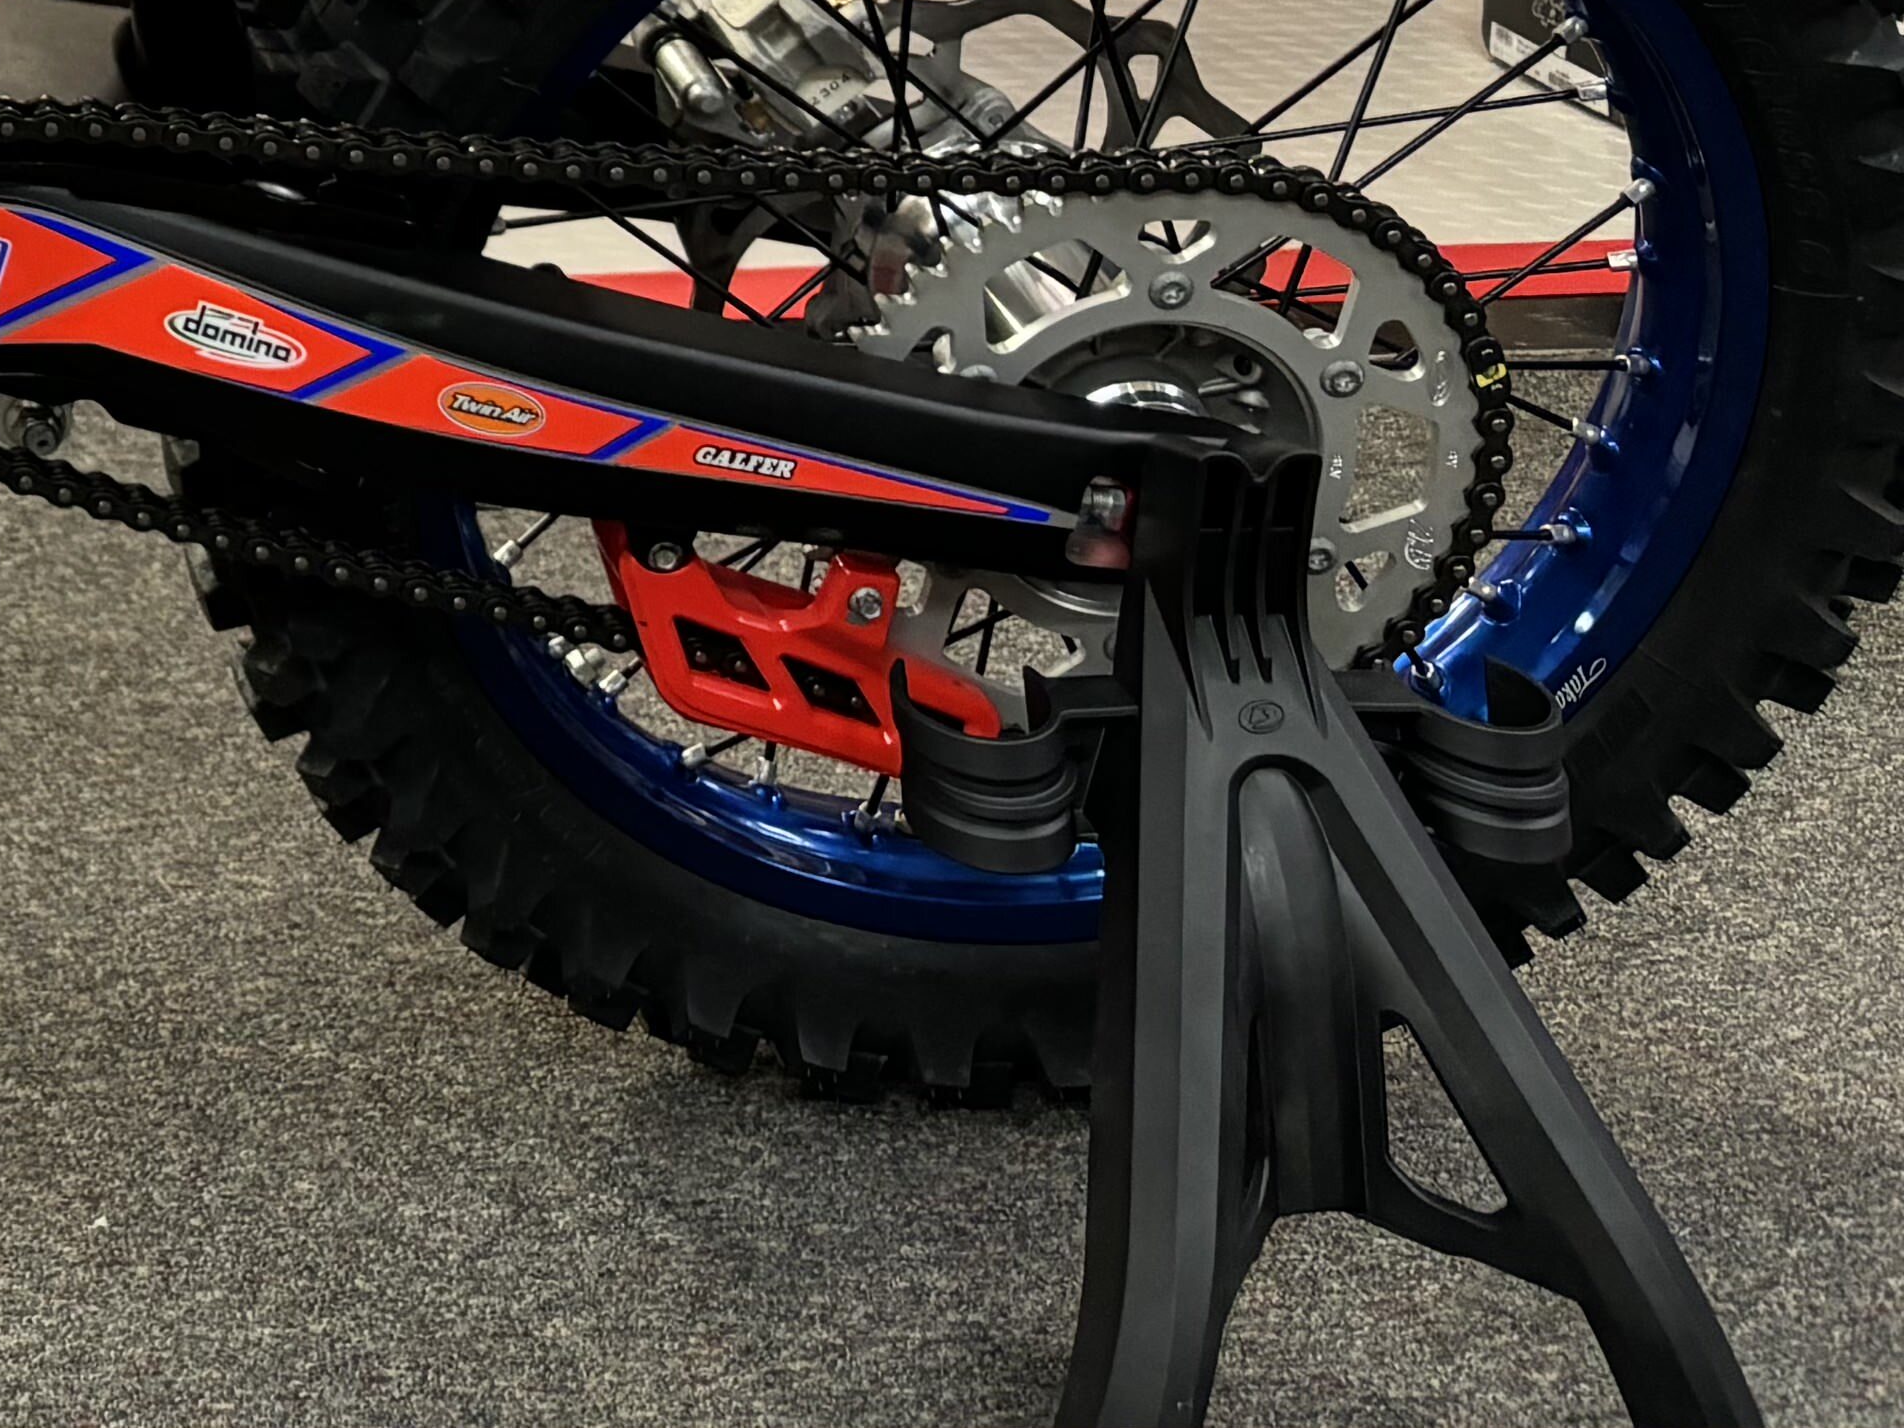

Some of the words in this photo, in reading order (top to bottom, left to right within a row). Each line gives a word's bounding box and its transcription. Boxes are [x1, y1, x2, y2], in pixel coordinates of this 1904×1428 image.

[180, 304, 299, 365] domino
[448, 394, 504, 420] Twin
[504, 408, 538, 430] Air
[695, 444, 797, 480] GALFER
